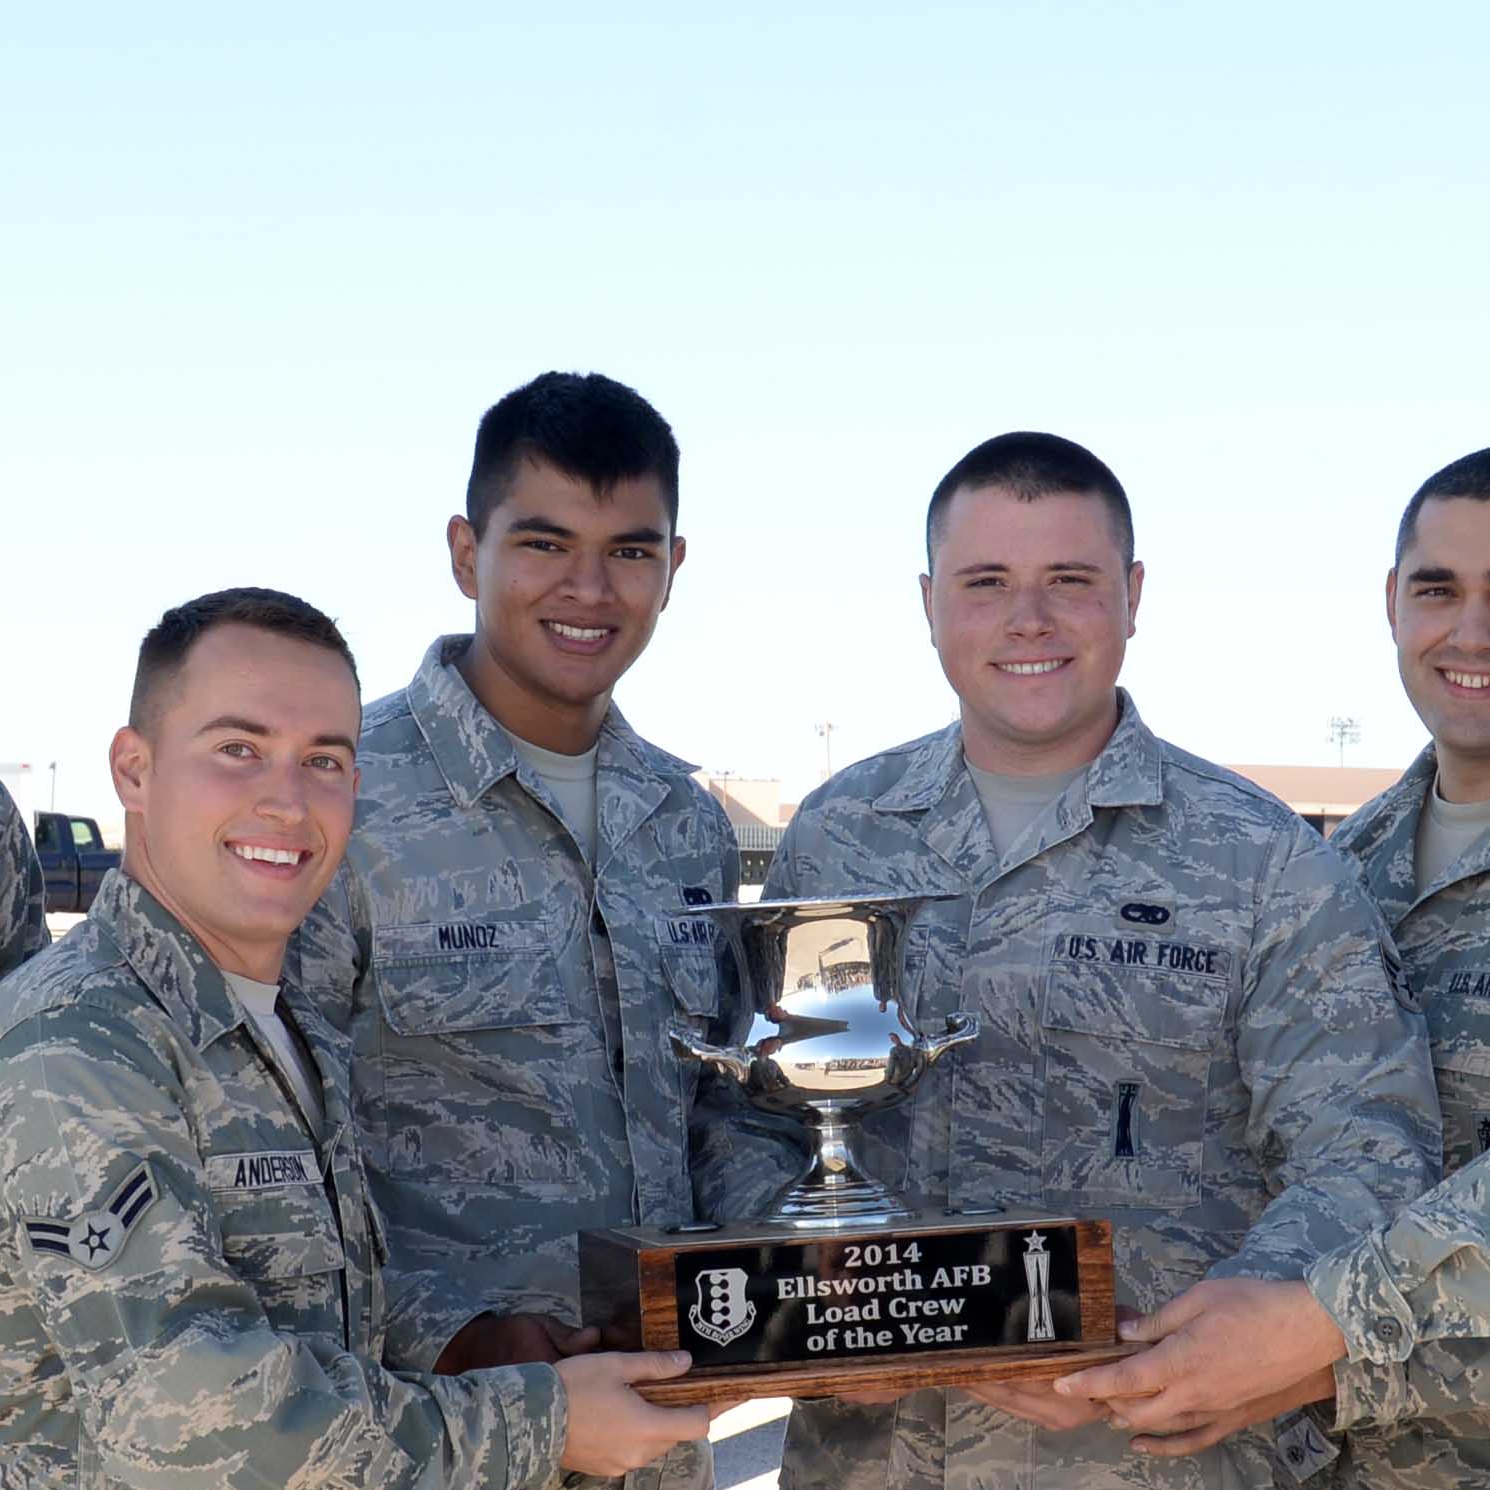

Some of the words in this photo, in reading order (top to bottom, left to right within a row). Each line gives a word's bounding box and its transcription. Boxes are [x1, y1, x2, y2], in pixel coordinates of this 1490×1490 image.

[438, 923, 499, 950] MUNOZ
[1069, 936, 1100, 961] U.S.
[1110, 939, 1148, 965] AIR
[1157, 943, 1218, 974] FORCE
[234, 1155, 309, 1188] ANDERSON
[844, 1242, 923, 1268] 2014
[776, 1268, 924, 1300] Ellsworth
[930, 1264, 992, 1289] AFB
[806, 1298, 881, 1325] Load
[888, 1297, 966, 1319] Crew
[806, 1328, 840, 1352] of
[843, 1326, 893, 1349] the
[899, 1323, 969, 1346] Year
